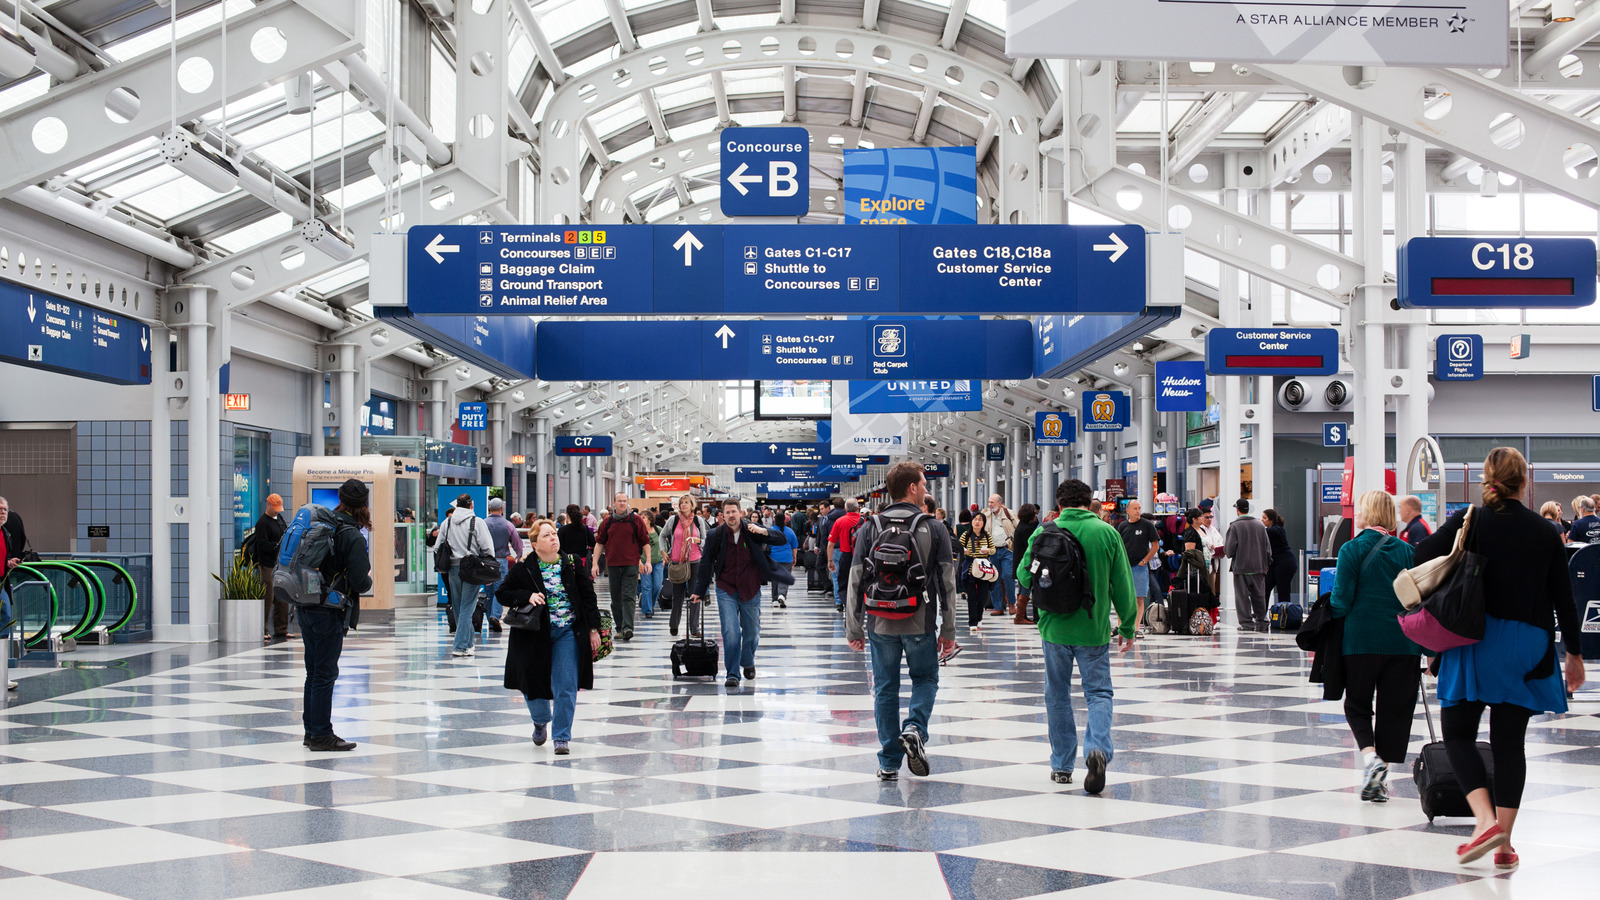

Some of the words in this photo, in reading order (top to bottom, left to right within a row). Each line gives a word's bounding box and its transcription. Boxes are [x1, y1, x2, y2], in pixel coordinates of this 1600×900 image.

[1236, 14, 1246, 24] A
[1250, 14, 1289, 25] STAR
[1293, 15, 1369, 27] ALLIANCE
[1372, 16, 1439, 28] MEMBER
[726, 141, 803, 153] Concourse
[768, 161, 799, 197] B
[860, 197, 926, 214] Explore
[500, 232, 562, 243] Terminals
[500, 248, 571, 259] Concourses
[576, 248, 586, 258] B
[590, 248, 600, 258] E
[605, 248, 614, 258] F
[764, 247, 802, 258] Gates
[804, 247, 852, 258] C1-C17
[932, 246, 978, 259] Gates
[983, 246, 1052, 261] C18,C18a
[1471, 242, 1535, 271] C18
[500, 263, 555, 276] Baggage
[558, 263, 595, 275] Claim
[764, 263, 810, 274] Shuttle
[813, 263, 827, 274] to
[936, 262, 999, 274] Customer
[1003, 262, 1052, 274] Service
[500, 279, 544, 290] Ground
[546, 279, 604, 291] Transport
[764, 279, 841, 290] Concourses
[850, 279, 859, 289] E
[868, 279, 877, 289] F
[998, 275, 1043, 287] Center
[500, 295, 541, 306] Animal
[544, 295, 578, 306] Relief
[579, 295, 608, 306] Area
[776, 335, 801, 343] Gates
[803, 335, 835, 343] C1-C17
[1236, 331, 1279, 340] Customer
[1279, 331, 1312, 340] Service
[776, 346, 807, 354] Shuttle
[808, 346, 818, 354] to
[1259, 342, 1289, 350] Center
[776, 357, 827, 365] Concourses
[886, 361, 909, 370] Carpet
[887, 381, 951, 391] UNITED
[1161, 376, 1202, 387] Hudson
[1161, 387, 1193, 398] News
[226, 394, 248, 407] EXIT
[461, 413, 484, 421] DUTY
[461, 420, 484, 428] FREE
[574, 436, 593, 447] C17
[338, 469, 361, 477] Mileage
[1552, 473, 1585, 481] Telephone
